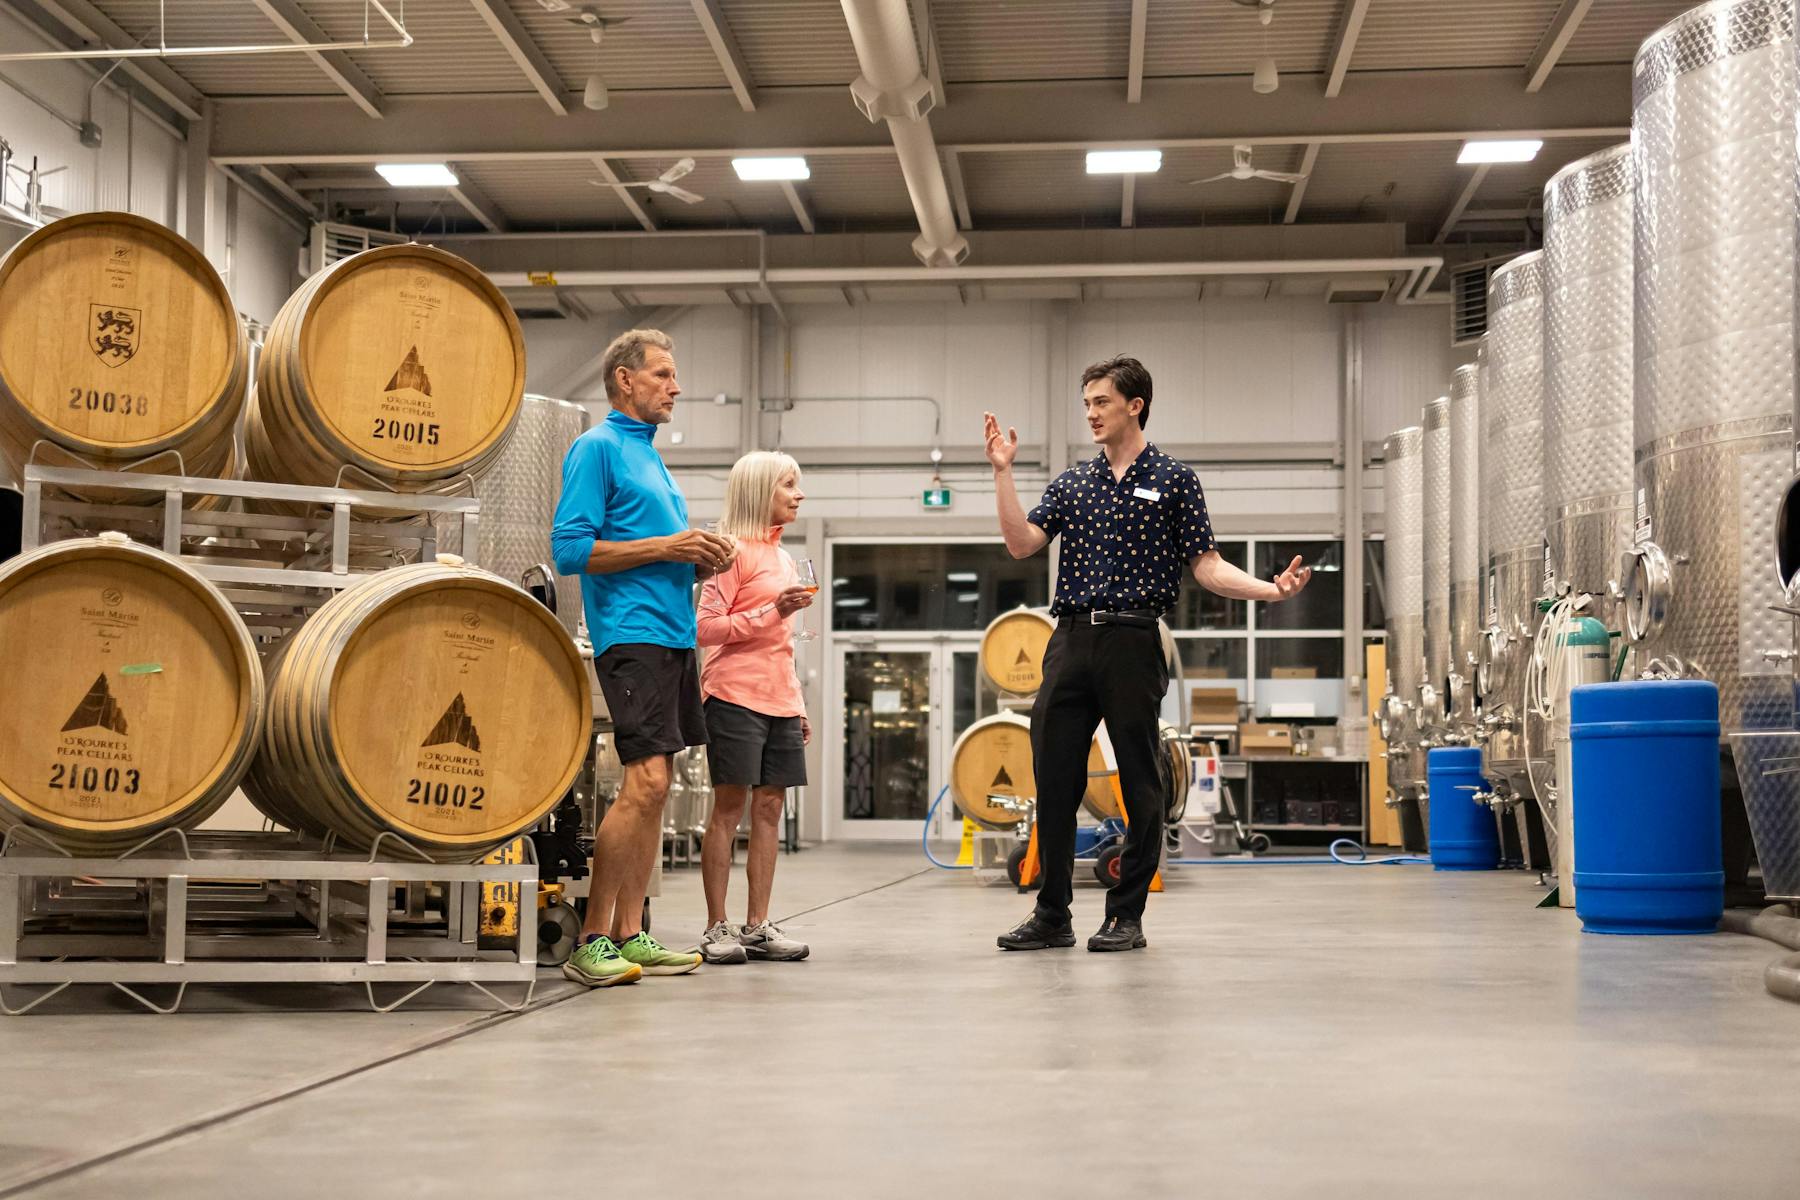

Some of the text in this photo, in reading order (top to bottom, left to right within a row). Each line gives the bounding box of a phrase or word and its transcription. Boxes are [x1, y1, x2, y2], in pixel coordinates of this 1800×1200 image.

[69, 387, 148, 416] 20038
[373, 418, 440, 445] 20015
[57, 746, 133, 762] PEAK CELLARS
[49, 764, 140, 794] 21003
[417, 761, 485, 777] PEAK CELLARS
[407, 778, 485, 810] 21002
